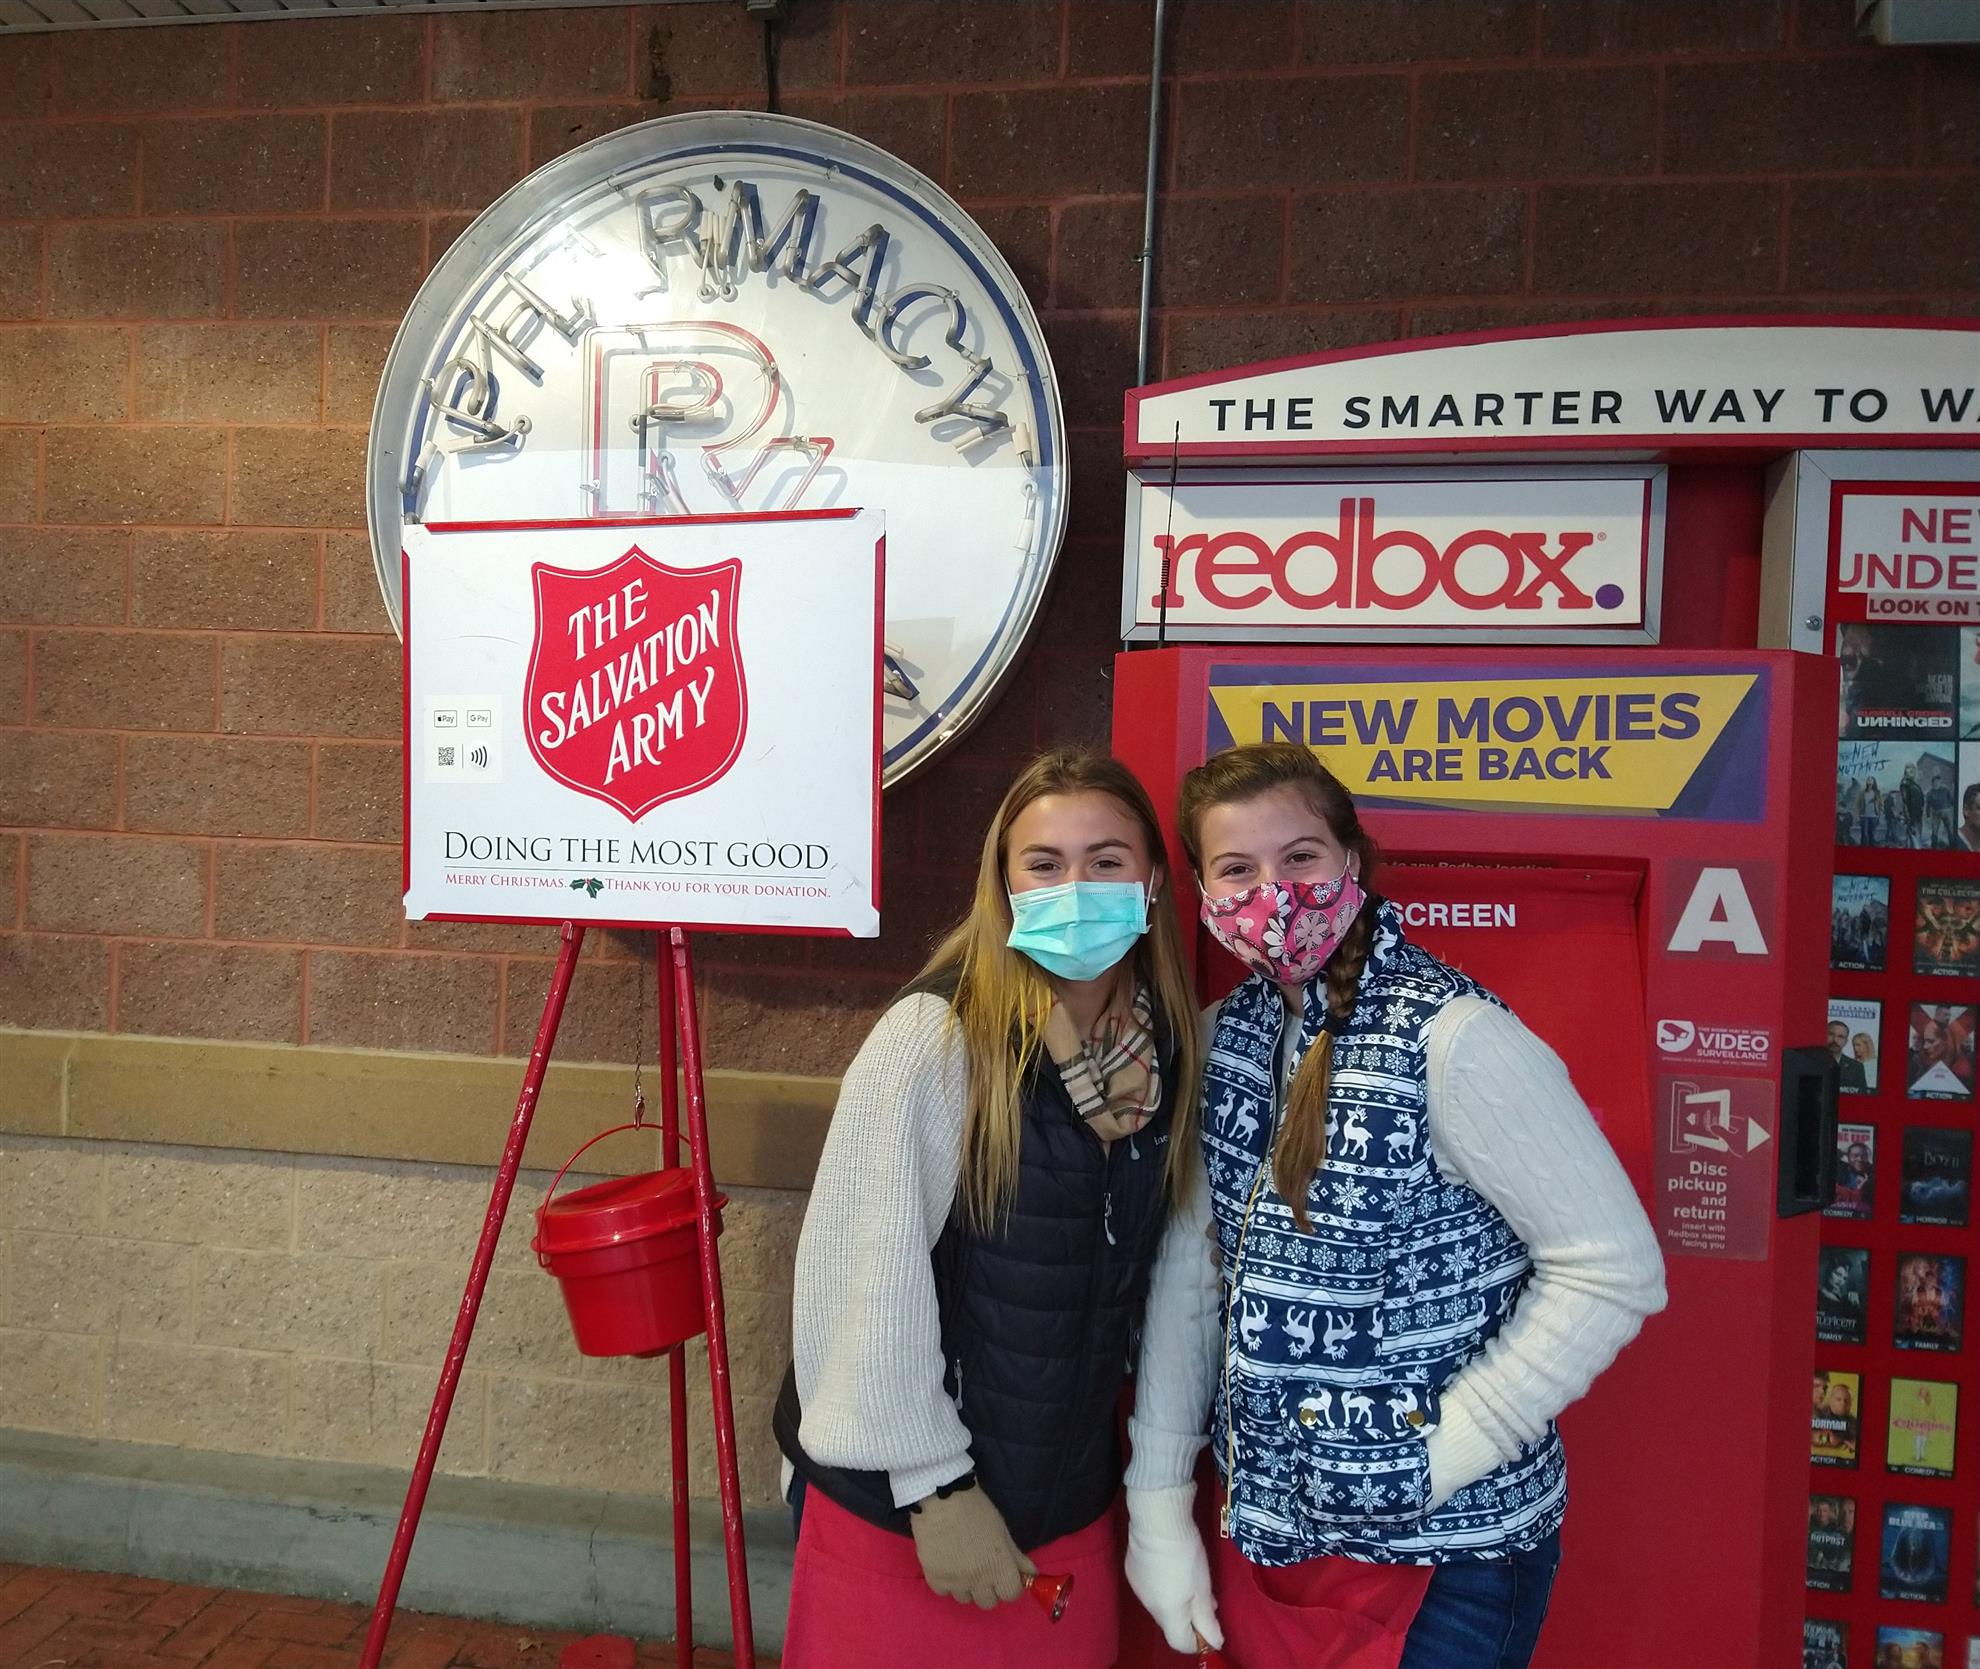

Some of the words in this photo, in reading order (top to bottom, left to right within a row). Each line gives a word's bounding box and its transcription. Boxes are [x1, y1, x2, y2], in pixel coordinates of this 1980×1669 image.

[430, 180, 1010, 446] PHRMACY
[1209, 397, 1314, 431] THE
[1342, 390, 1623, 429] SMARTER
[1654, 389, 1786, 423] WAY
[1814, 388, 1889, 422] TO
[1901, 508, 1980, 544] NE
[1869, 598, 1930, 615] LOOK
[1936, 600, 1970, 616] ON
[567, 577, 649, 662] THE
[539, 588, 720, 749] SALVATION
[602, 665, 715, 786] ARMY
[1262, 698, 1419, 746] NEW
[1438, 692, 1701, 744] MOVIES
[1366, 747, 1463, 782] ARE
[1479, 745, 1613, 781] BACK
[444, 832, 553, 862] DOING
[560, 838, 621, 864] THE
[630, 840, 719, 866] MOST
[446, 873, 487, 886] MERRY
[490, 874, 567, 888] CHRISTMAS.
[605, 878, 651, 892] THANK
[654, 881, 681, 893] YOU
[685, 883, 711, 894] FOR
[714, 884, 750, 895] YOUR
[754, 885, 831, 898] DONATION.
[1390, 902, 1516, 928] SCREEN
[1667, 867, 1769, 955] A
[1838, 961, 1865, 970] ACTION
[1932, 968, 1960, 976] ACTION
[1698, 1032, 1769, 1051] VIDEO
[1696, 1048, 1768, 1061] SURVEILLANCE
[1689, 1160, 1728, 1176] Disc
[1667, 1176, 1727, 1195] pickup
[1701, 1196, 1727, 1207] and
[1673, 1206, 1726, 1221] return
[1668, 1229, 1700, 1239] Redbox
[1701, 1233, 1726, 1241] name
[1681, 1222, 1706, 1231] insert
[1707, 1223, 1726, 1233] with
[1682, 1239, 1708, 1249] facing
[1709, 1241, 1726, 1250] you
